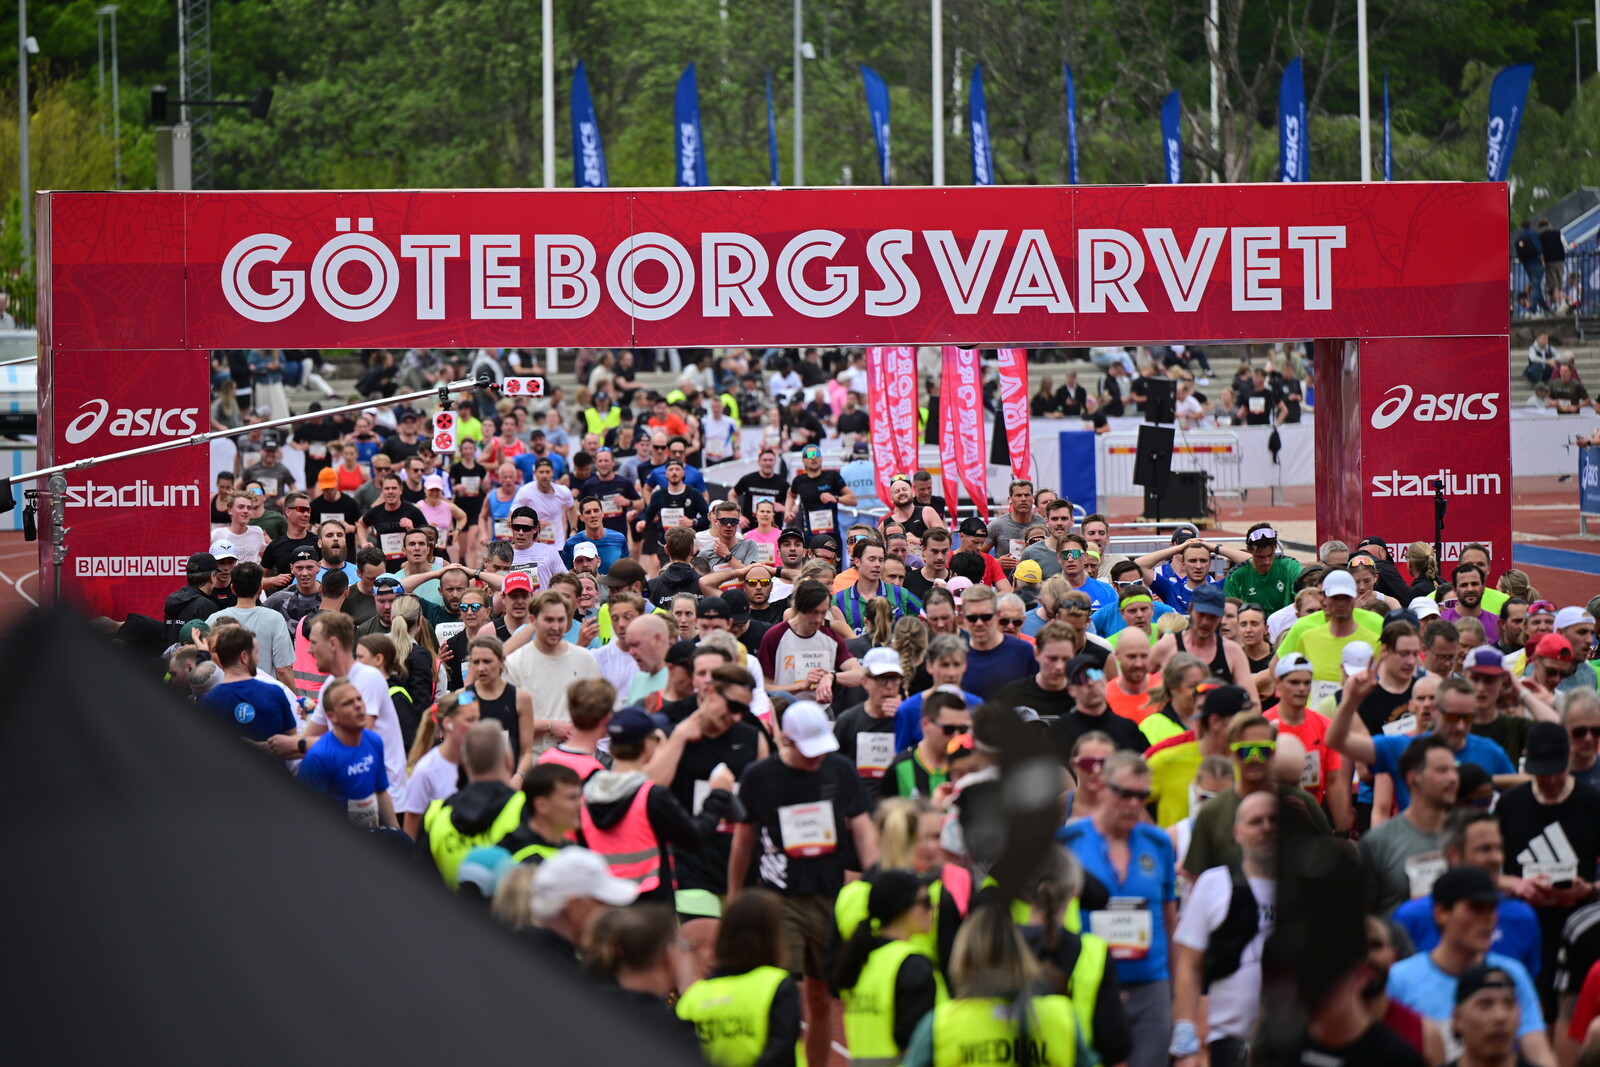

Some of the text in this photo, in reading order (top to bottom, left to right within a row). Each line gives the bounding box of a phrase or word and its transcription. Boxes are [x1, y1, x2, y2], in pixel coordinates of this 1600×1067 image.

[1286, 114, 1299, 178] asics
[221, 217, 1347, 323] GÖTEBORGSVARVET
[1413, 392, 1500, 422] asics
[109, 408, 199, 437] asics
[1371, 469, 1501, 497] stadium
[77, 558, 188, 575] BAUHAUS
[347, 761, 371, 777] NCC
